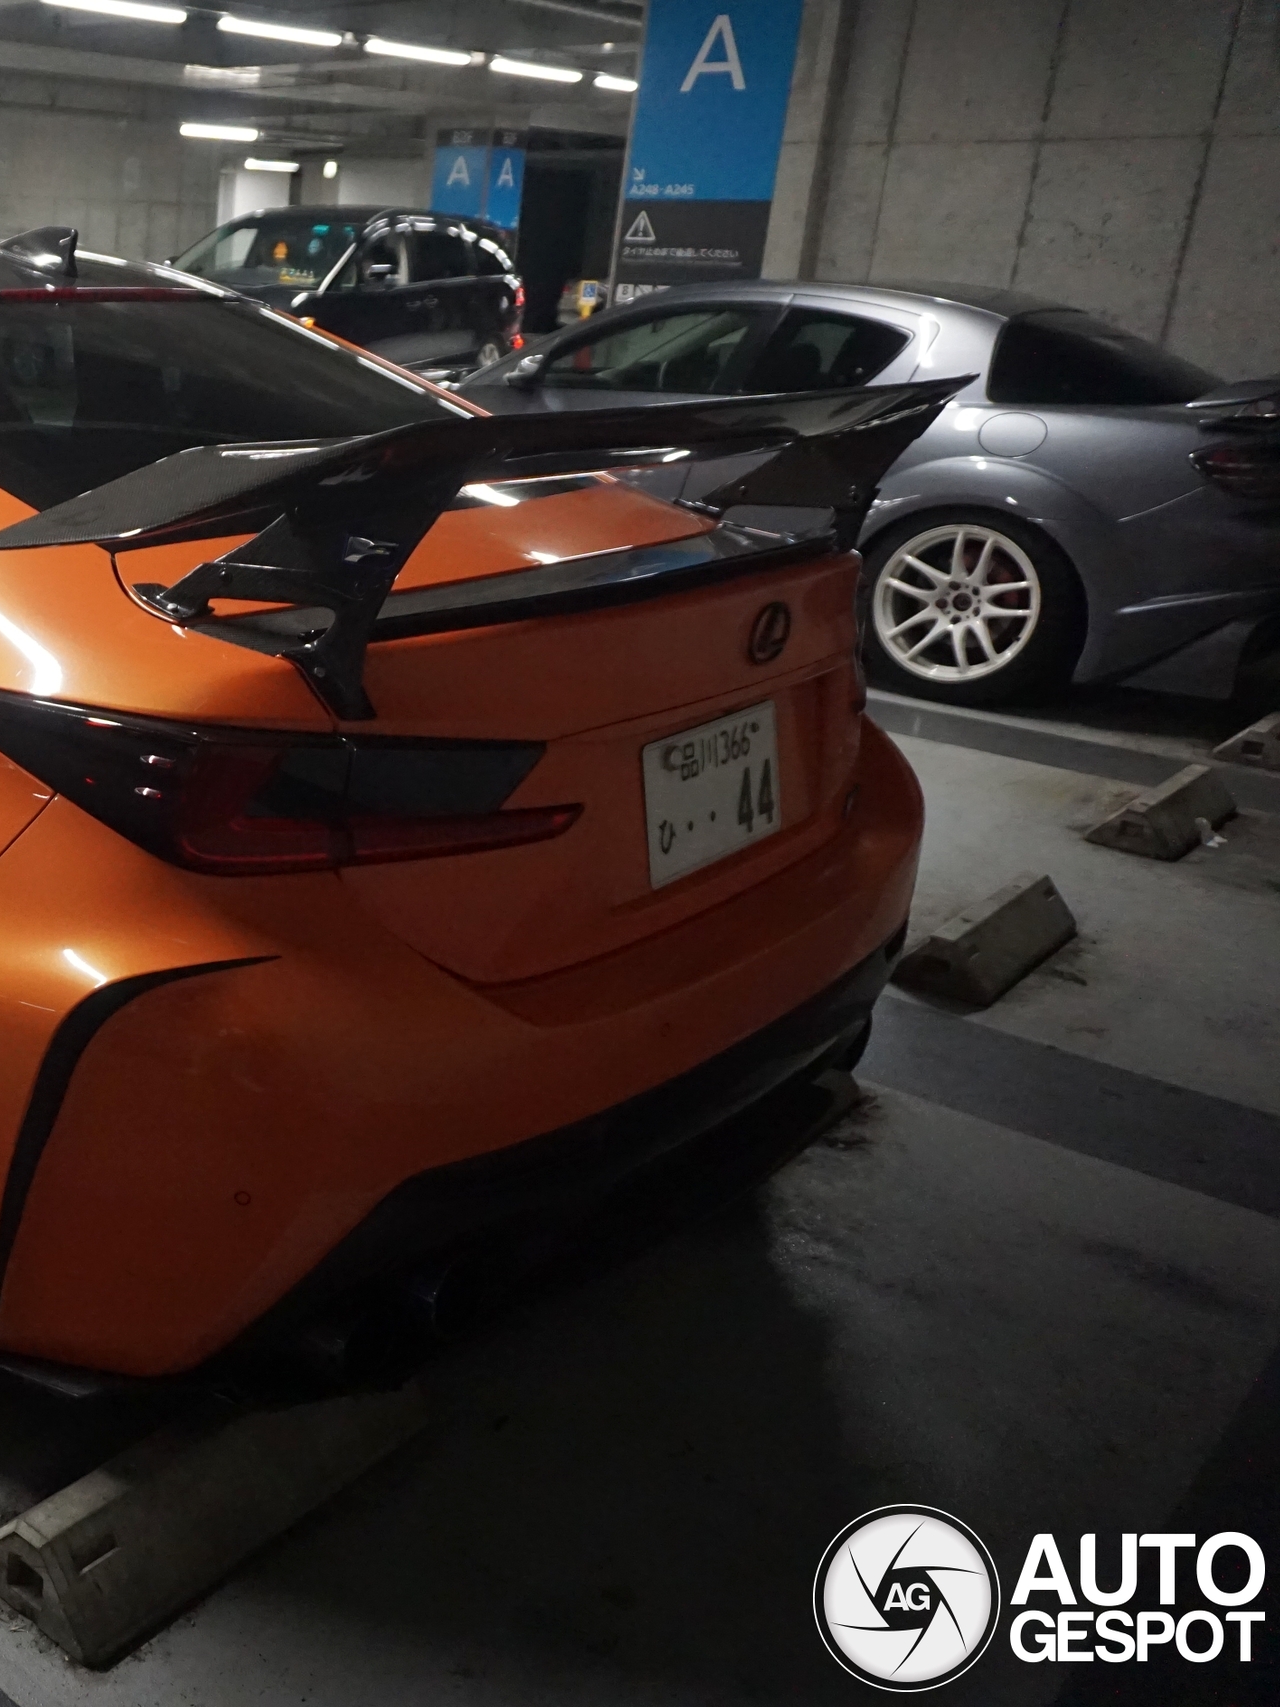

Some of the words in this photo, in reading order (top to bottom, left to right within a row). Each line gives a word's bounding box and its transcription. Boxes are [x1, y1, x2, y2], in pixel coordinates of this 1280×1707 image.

[680, 14, 746, 92] A
[446, 155, 470, 186] A
[497, 157, 514, 187] A
